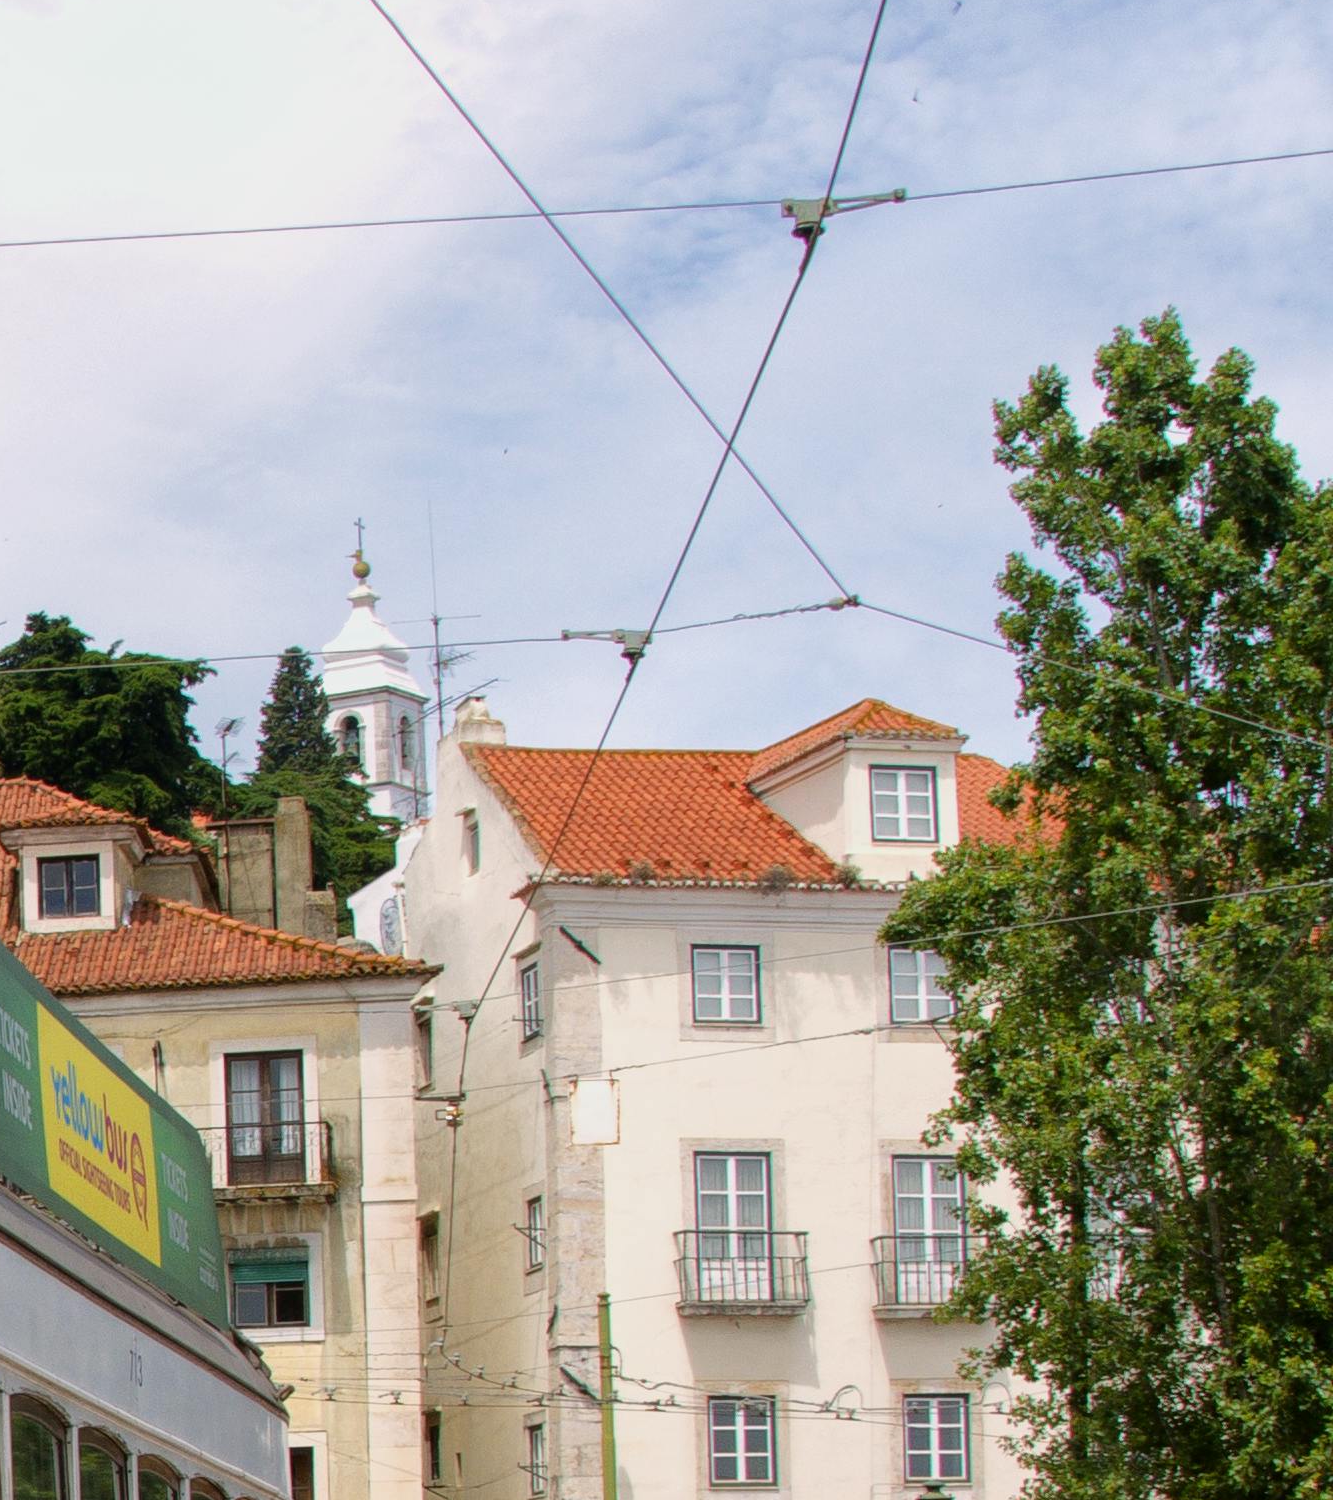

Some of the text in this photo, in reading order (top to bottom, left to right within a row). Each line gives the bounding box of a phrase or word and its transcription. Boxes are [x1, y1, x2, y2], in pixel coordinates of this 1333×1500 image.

[1, 1068, 33, 1131] INSIDE
[58, 1137, 132, 1214] OFFICIAL SIGHTSEEING TOURS
[161, 1151, 189, 1203] TICKETS
[129, 1349, 144, 1387] 713
